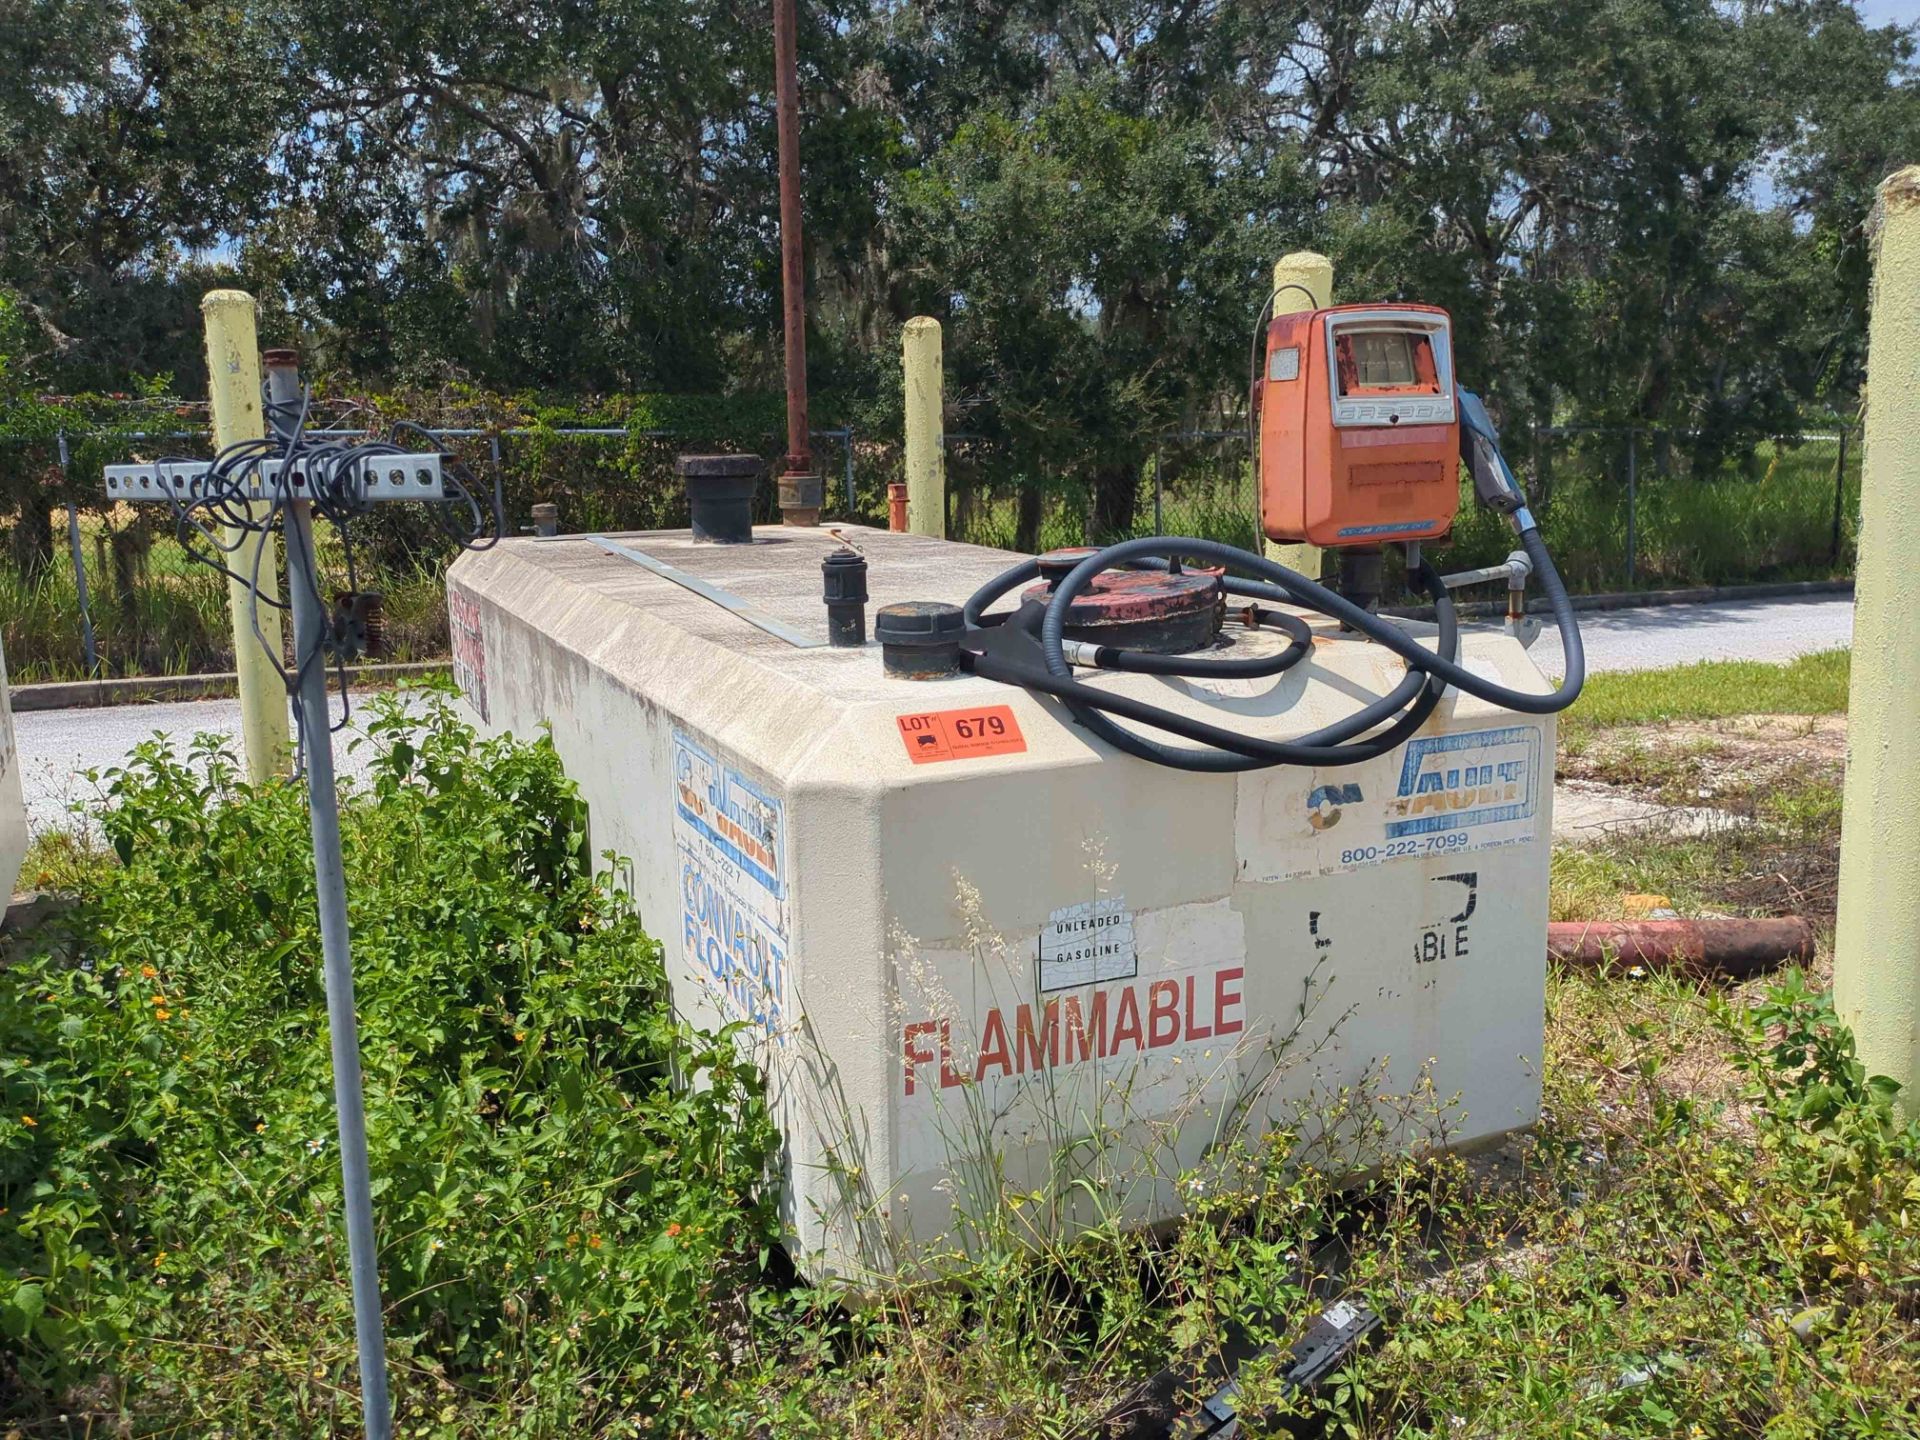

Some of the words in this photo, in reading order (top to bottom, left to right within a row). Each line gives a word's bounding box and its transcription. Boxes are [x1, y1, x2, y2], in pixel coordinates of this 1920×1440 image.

[955, 715, 1006, 739] 679
[1341, 832, 1469, 864] 800-222-7099
[1056, 914, 1121, 934] UNLEADED
[1057, 943, 1121, 963] GASOLINE
[904, 967, 1244, 1096] FLAMMABLE
